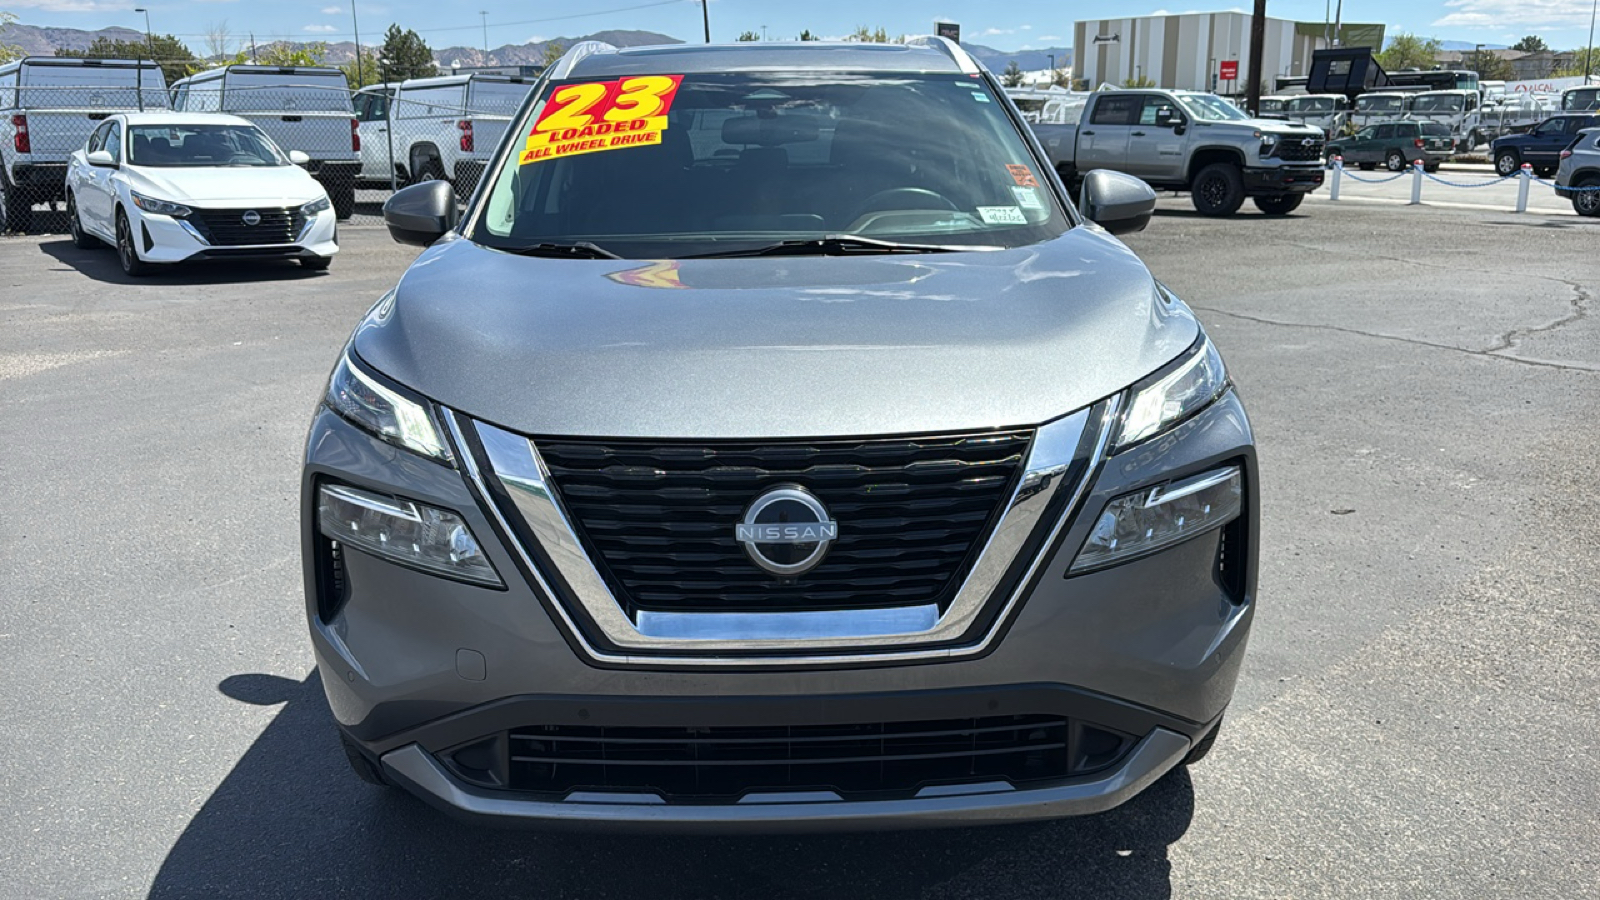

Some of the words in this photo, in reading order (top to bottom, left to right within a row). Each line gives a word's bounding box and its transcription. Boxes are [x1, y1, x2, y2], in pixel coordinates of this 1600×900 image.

[536, 76, 676, 131] 23
[549, 119, 648, 142] LOADED
[523, 147, 552, 161] ALL
[555, 139, 607, 155] WHEEL
[610, 132, 657, 146] DRIVE
[739, 525, 835, 539] NISSAN
